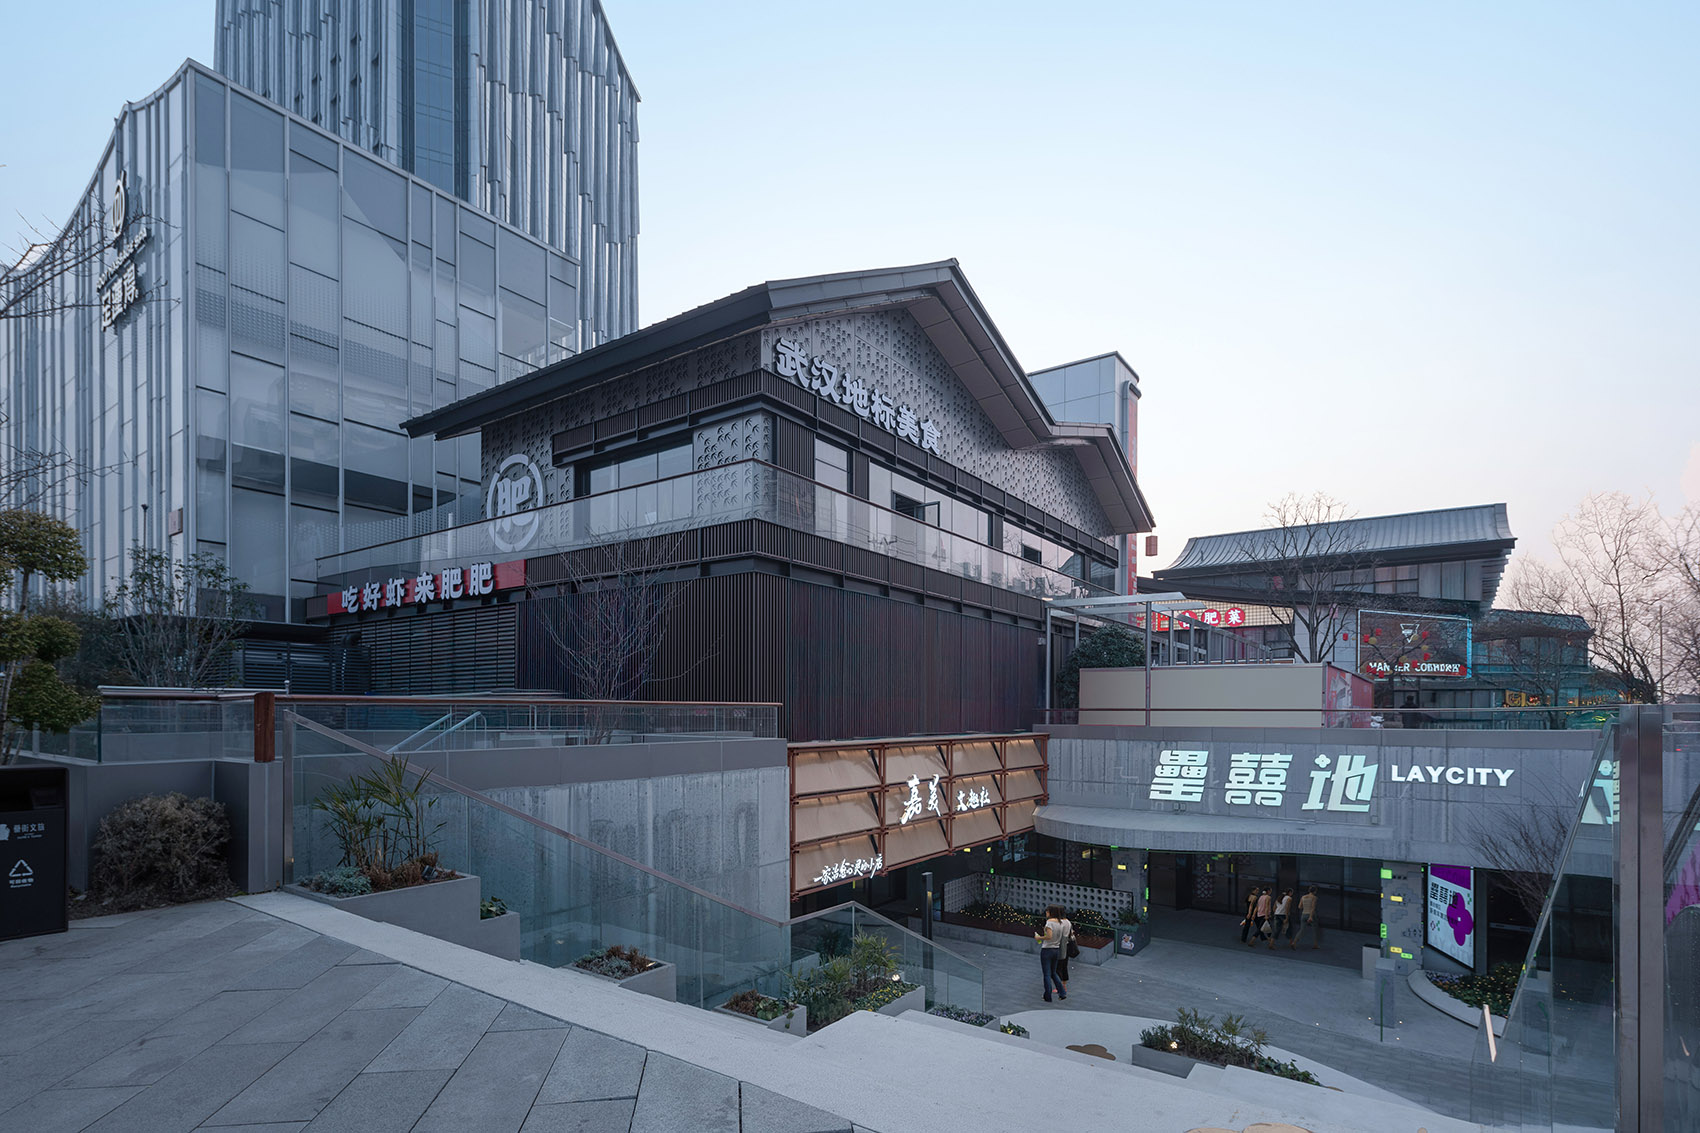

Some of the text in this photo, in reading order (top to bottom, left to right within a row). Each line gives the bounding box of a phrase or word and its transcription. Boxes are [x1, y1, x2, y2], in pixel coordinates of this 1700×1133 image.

[775, 337, 941, 454] 武汉地标美食
[341, 561, 494, 614] 吃好虾来肥肥
[1369, 662, 1410, 672] MANER
[1391, 764, 1515, 787] LAYCITY
